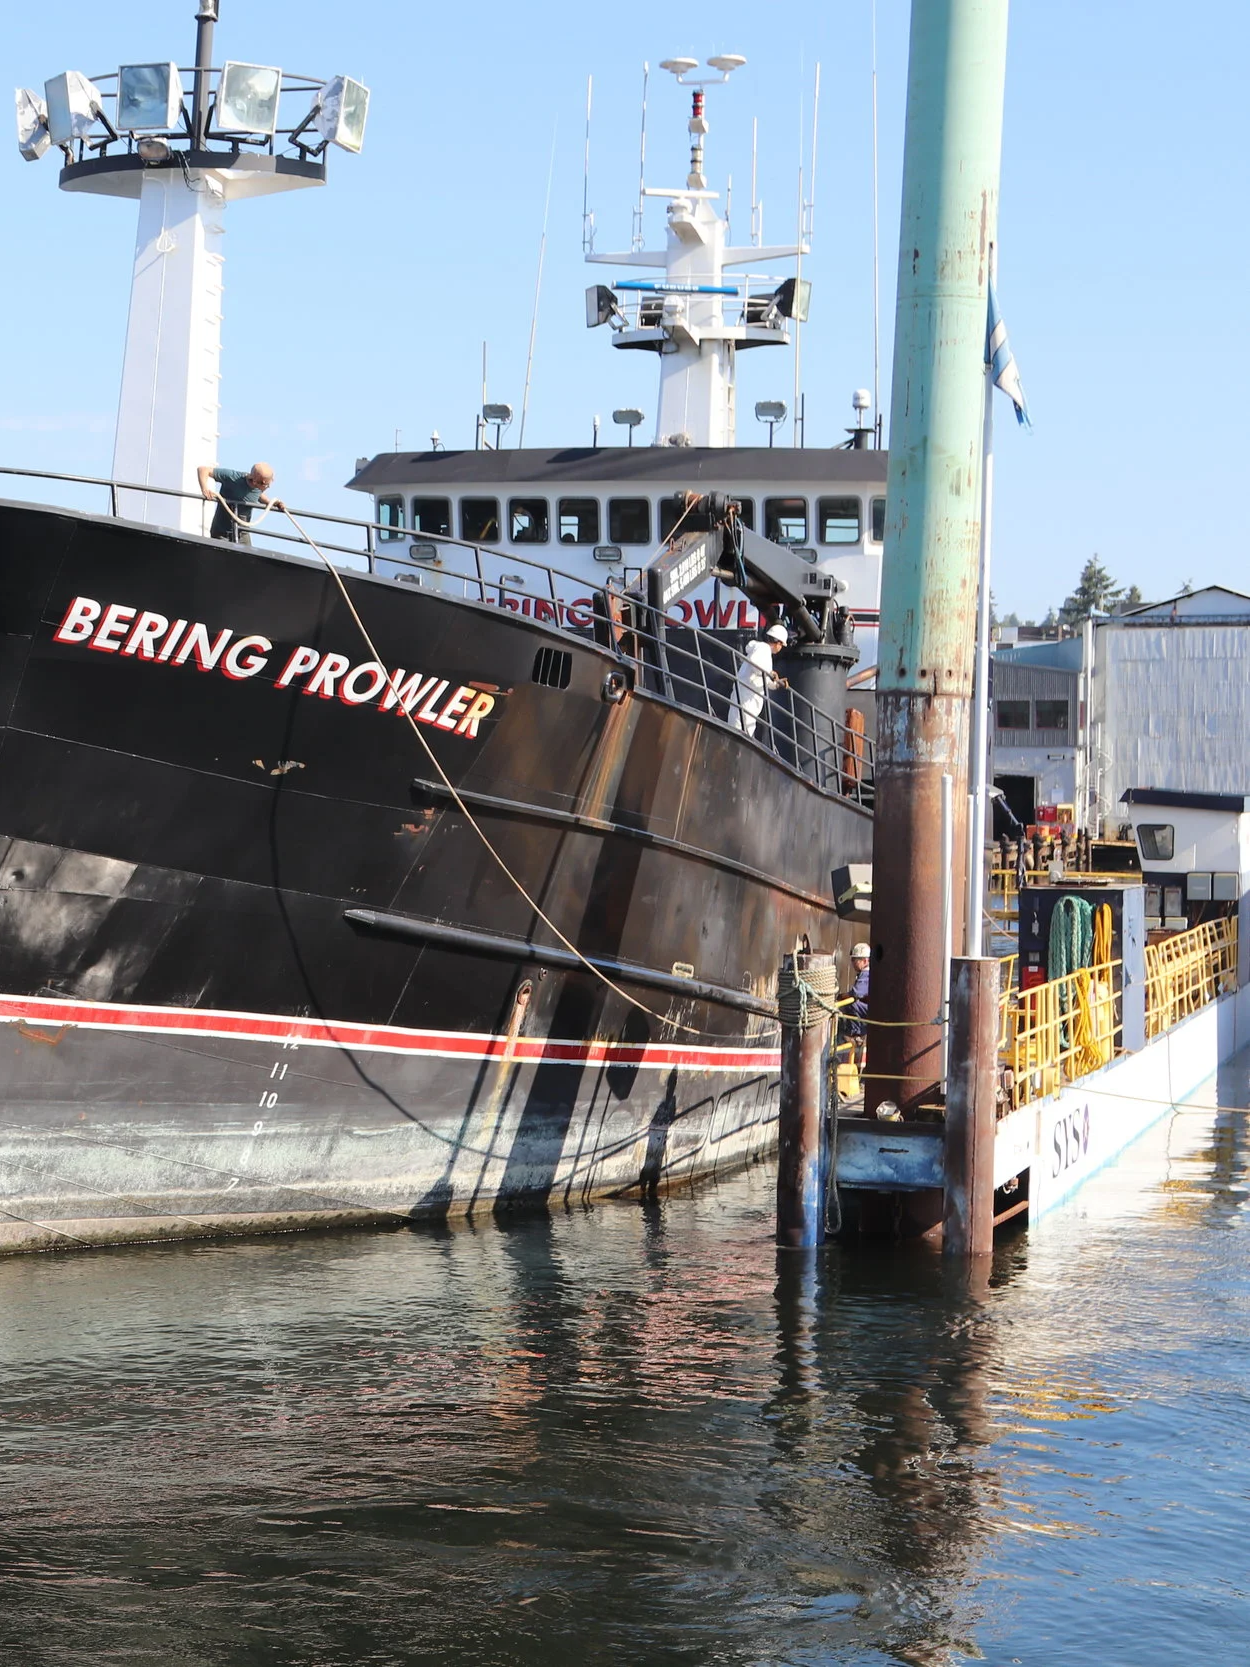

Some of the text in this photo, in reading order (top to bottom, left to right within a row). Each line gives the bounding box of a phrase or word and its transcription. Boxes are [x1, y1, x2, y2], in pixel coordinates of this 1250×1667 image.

[53, 596, 495, 739] BERING PROWLER
[270, 1062, 288, 1080] 11
[259, 1091, 278, 1108] 10
